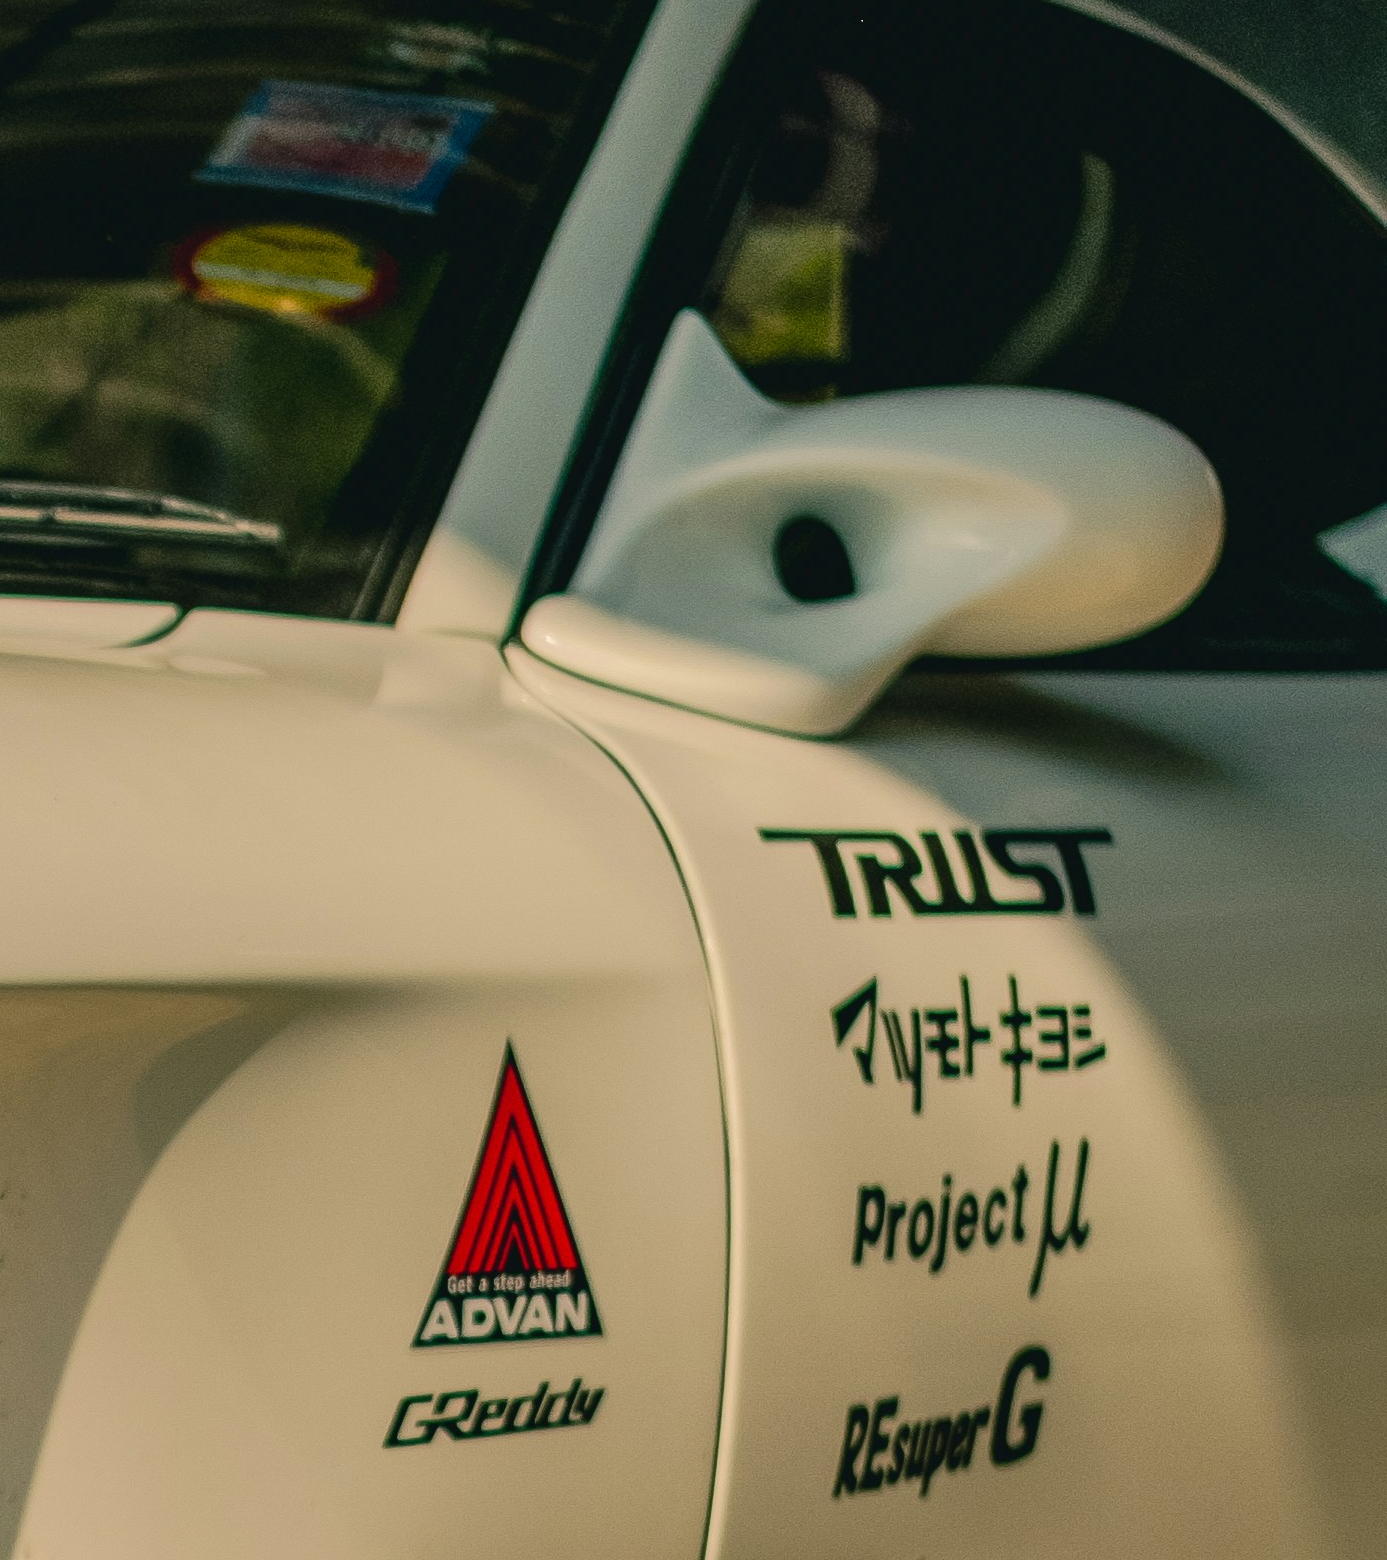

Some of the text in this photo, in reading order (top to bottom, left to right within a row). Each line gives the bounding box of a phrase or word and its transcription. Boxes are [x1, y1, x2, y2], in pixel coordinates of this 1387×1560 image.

[757, 827, 1112, 918] TRUST
[421, 1290, 588, 1342] ADVAN
[382, 1377, 607, 1448] GReddy
